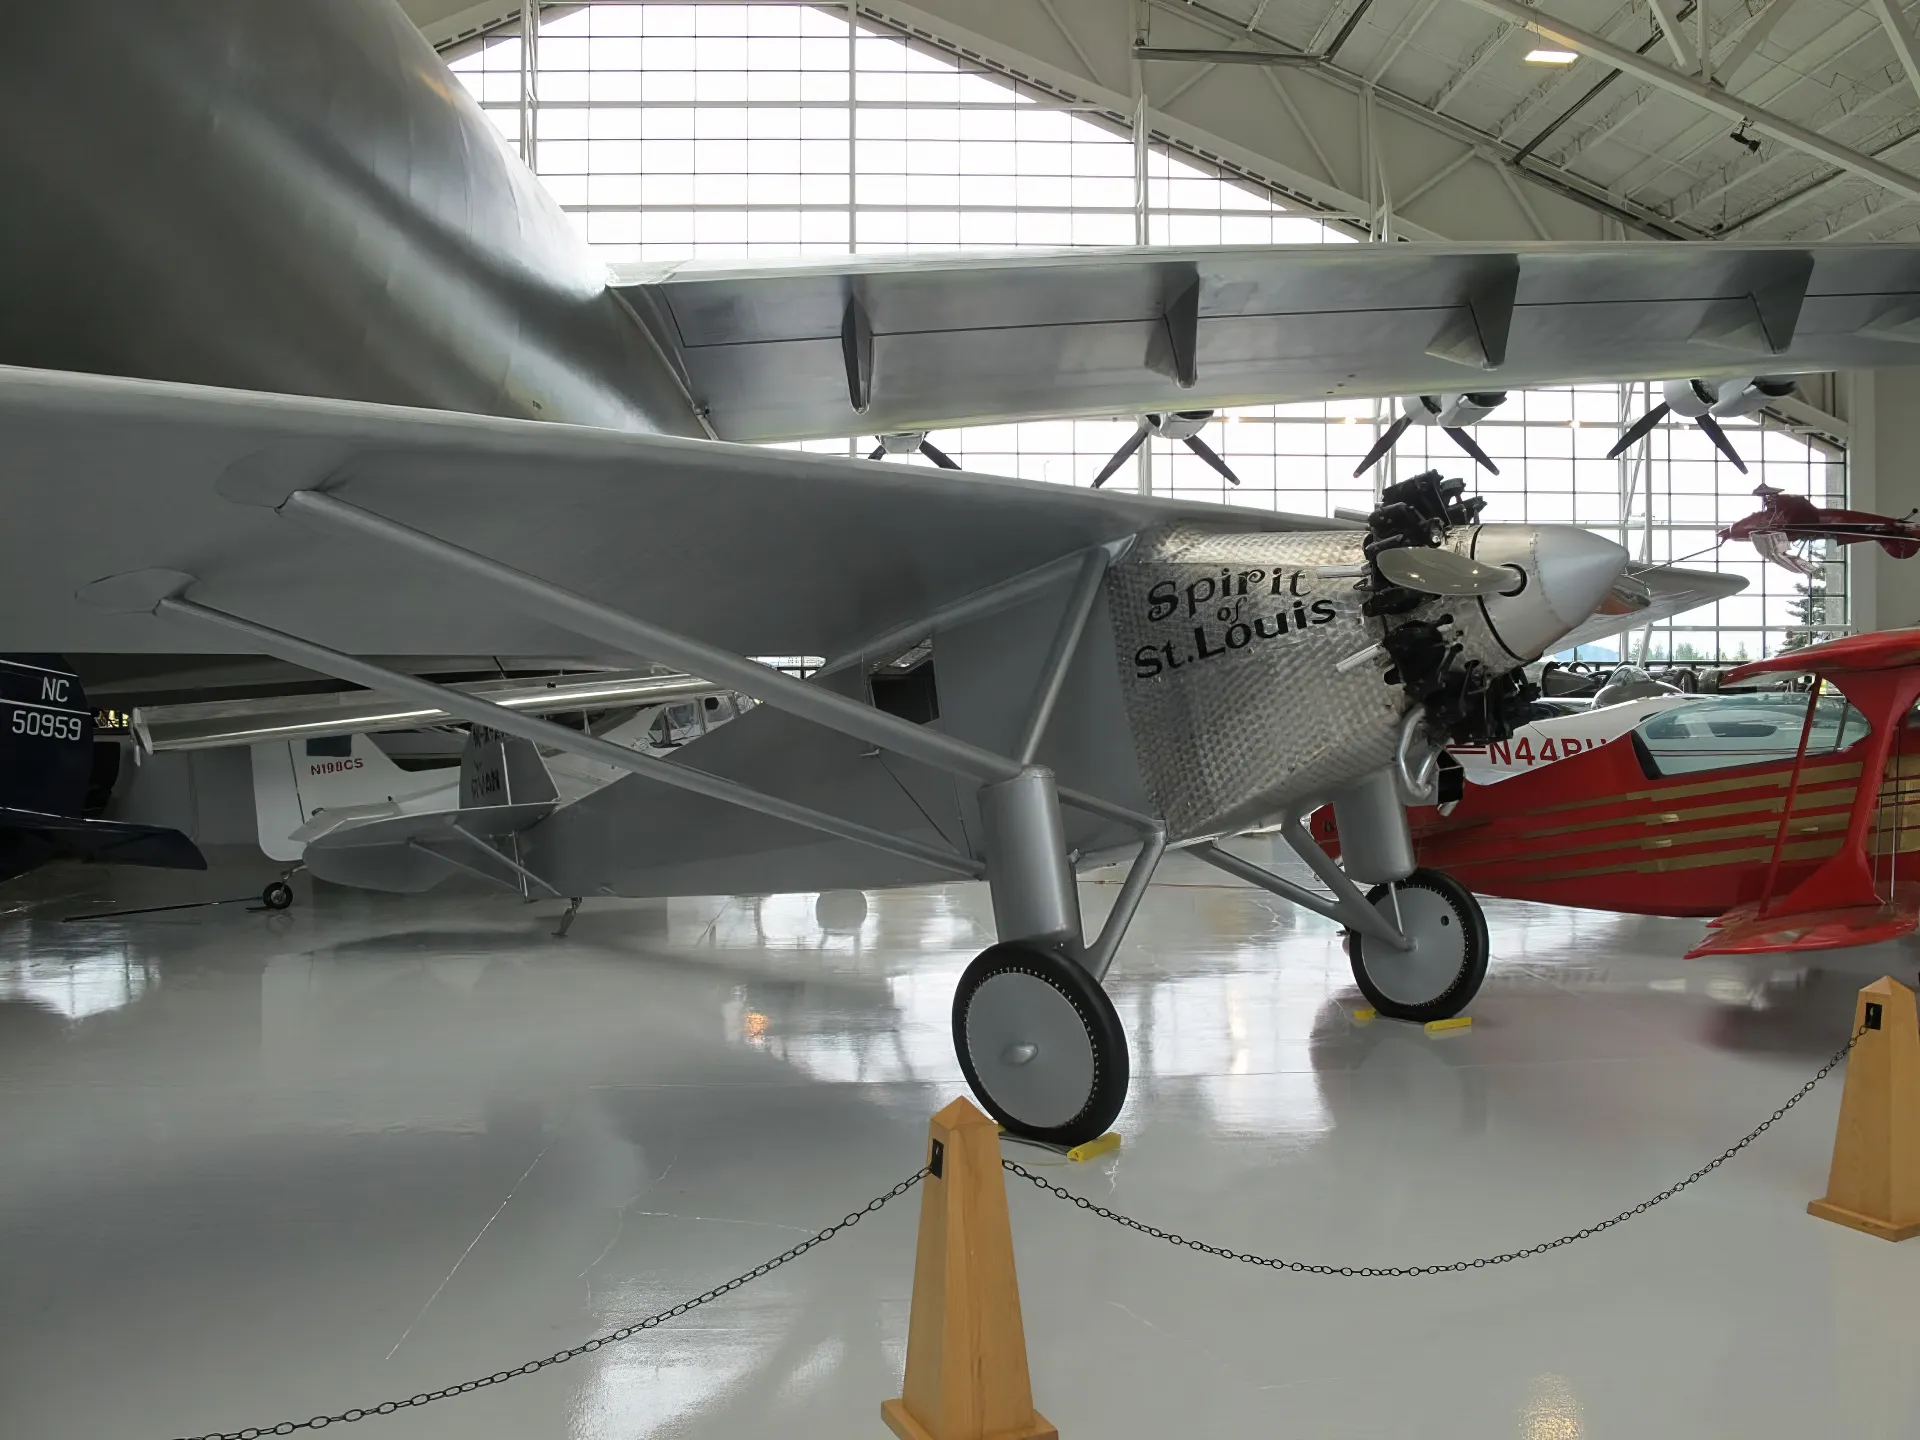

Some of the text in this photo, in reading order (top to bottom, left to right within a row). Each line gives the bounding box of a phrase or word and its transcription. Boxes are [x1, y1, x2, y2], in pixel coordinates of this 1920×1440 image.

[1148, 567, 1311, 622] Spirit
[1216, 596, 1248, 625] of
[41, 676, 70, 702] NC
[12, 710, 82, 741] 50959
